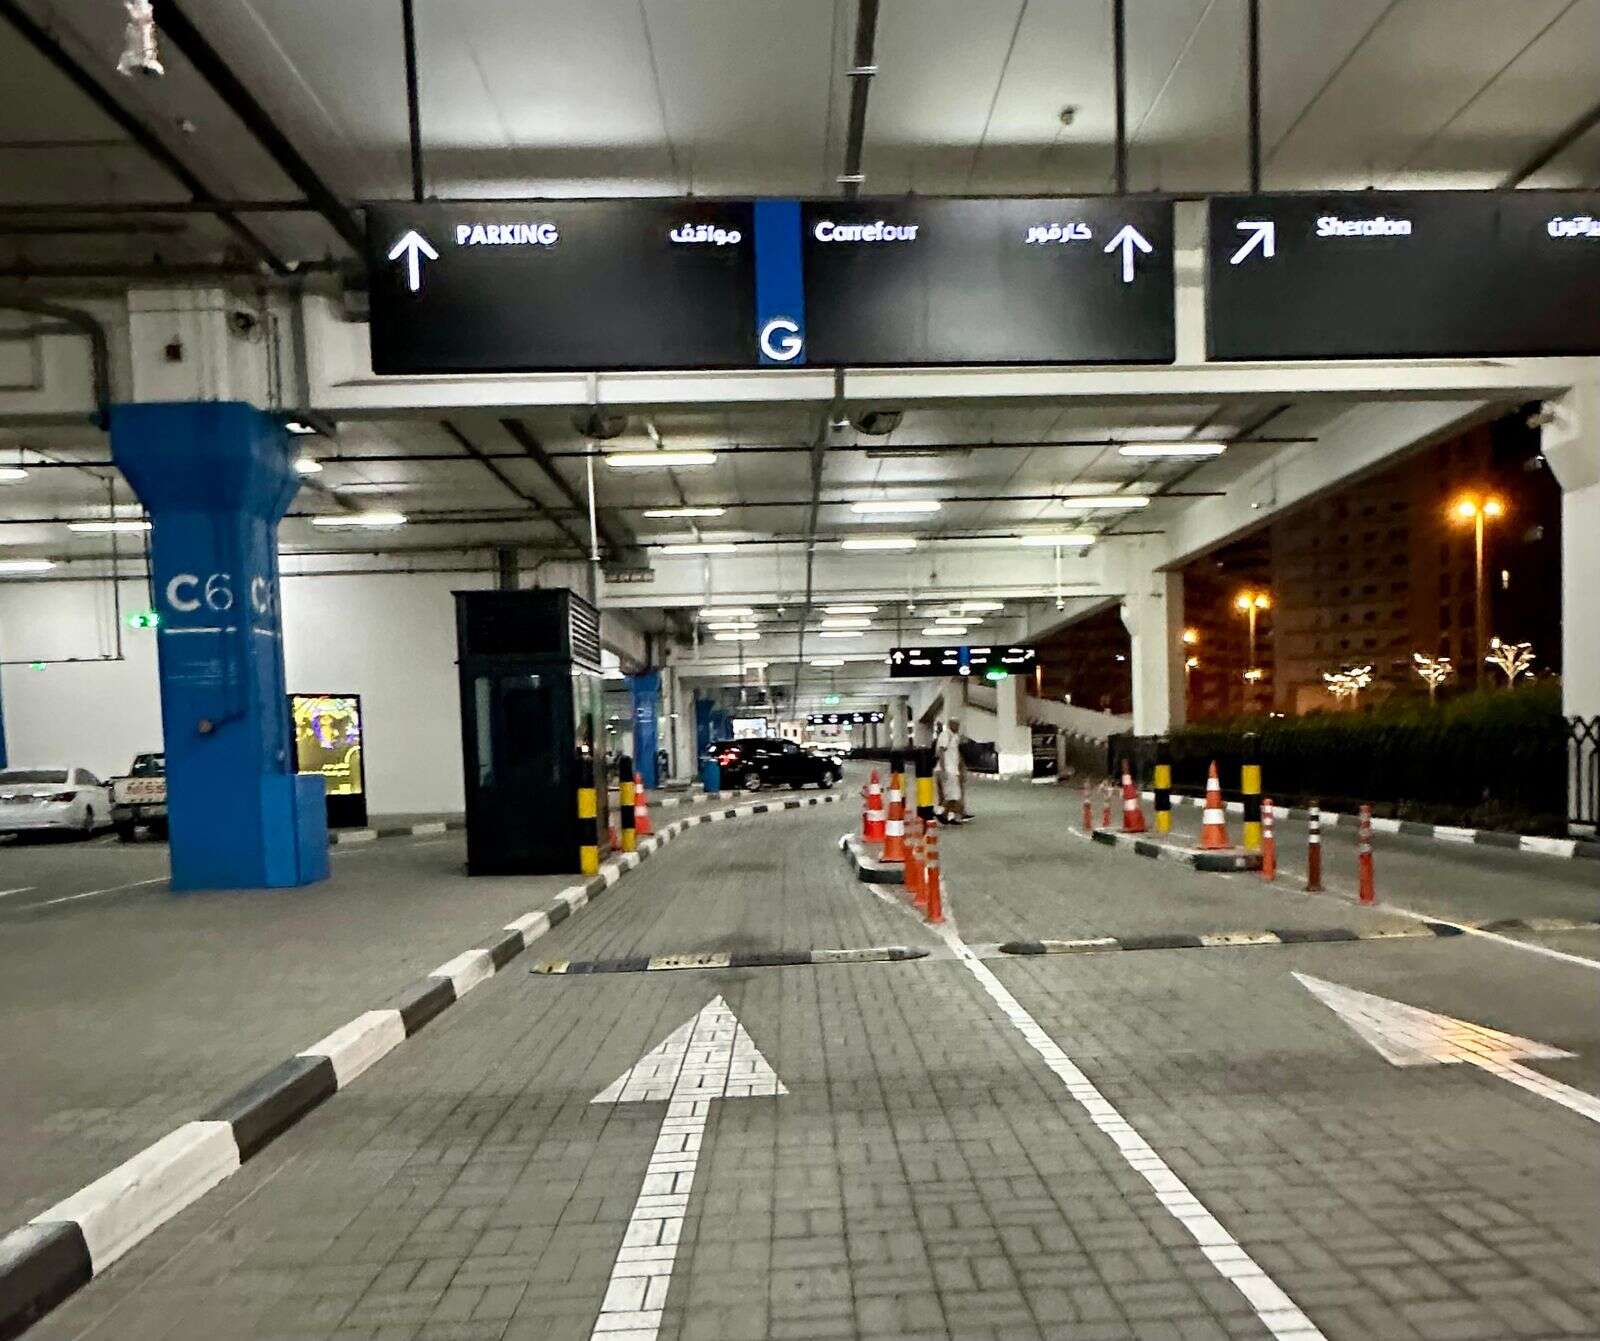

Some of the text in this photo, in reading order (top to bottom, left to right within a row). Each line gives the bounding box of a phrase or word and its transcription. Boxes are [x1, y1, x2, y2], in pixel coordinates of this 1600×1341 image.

[455, 222, 559, 246] PARKING
[670, 223, 742, 246] مواقف
[814, 220, 919, 243] Carrefour
[1025, 222, 1093, 244] كارفور
[1316, 216, 1412, 237] Sheraton
[760, 319, 803, 361] G
[166, 573, 234, 612] C6
